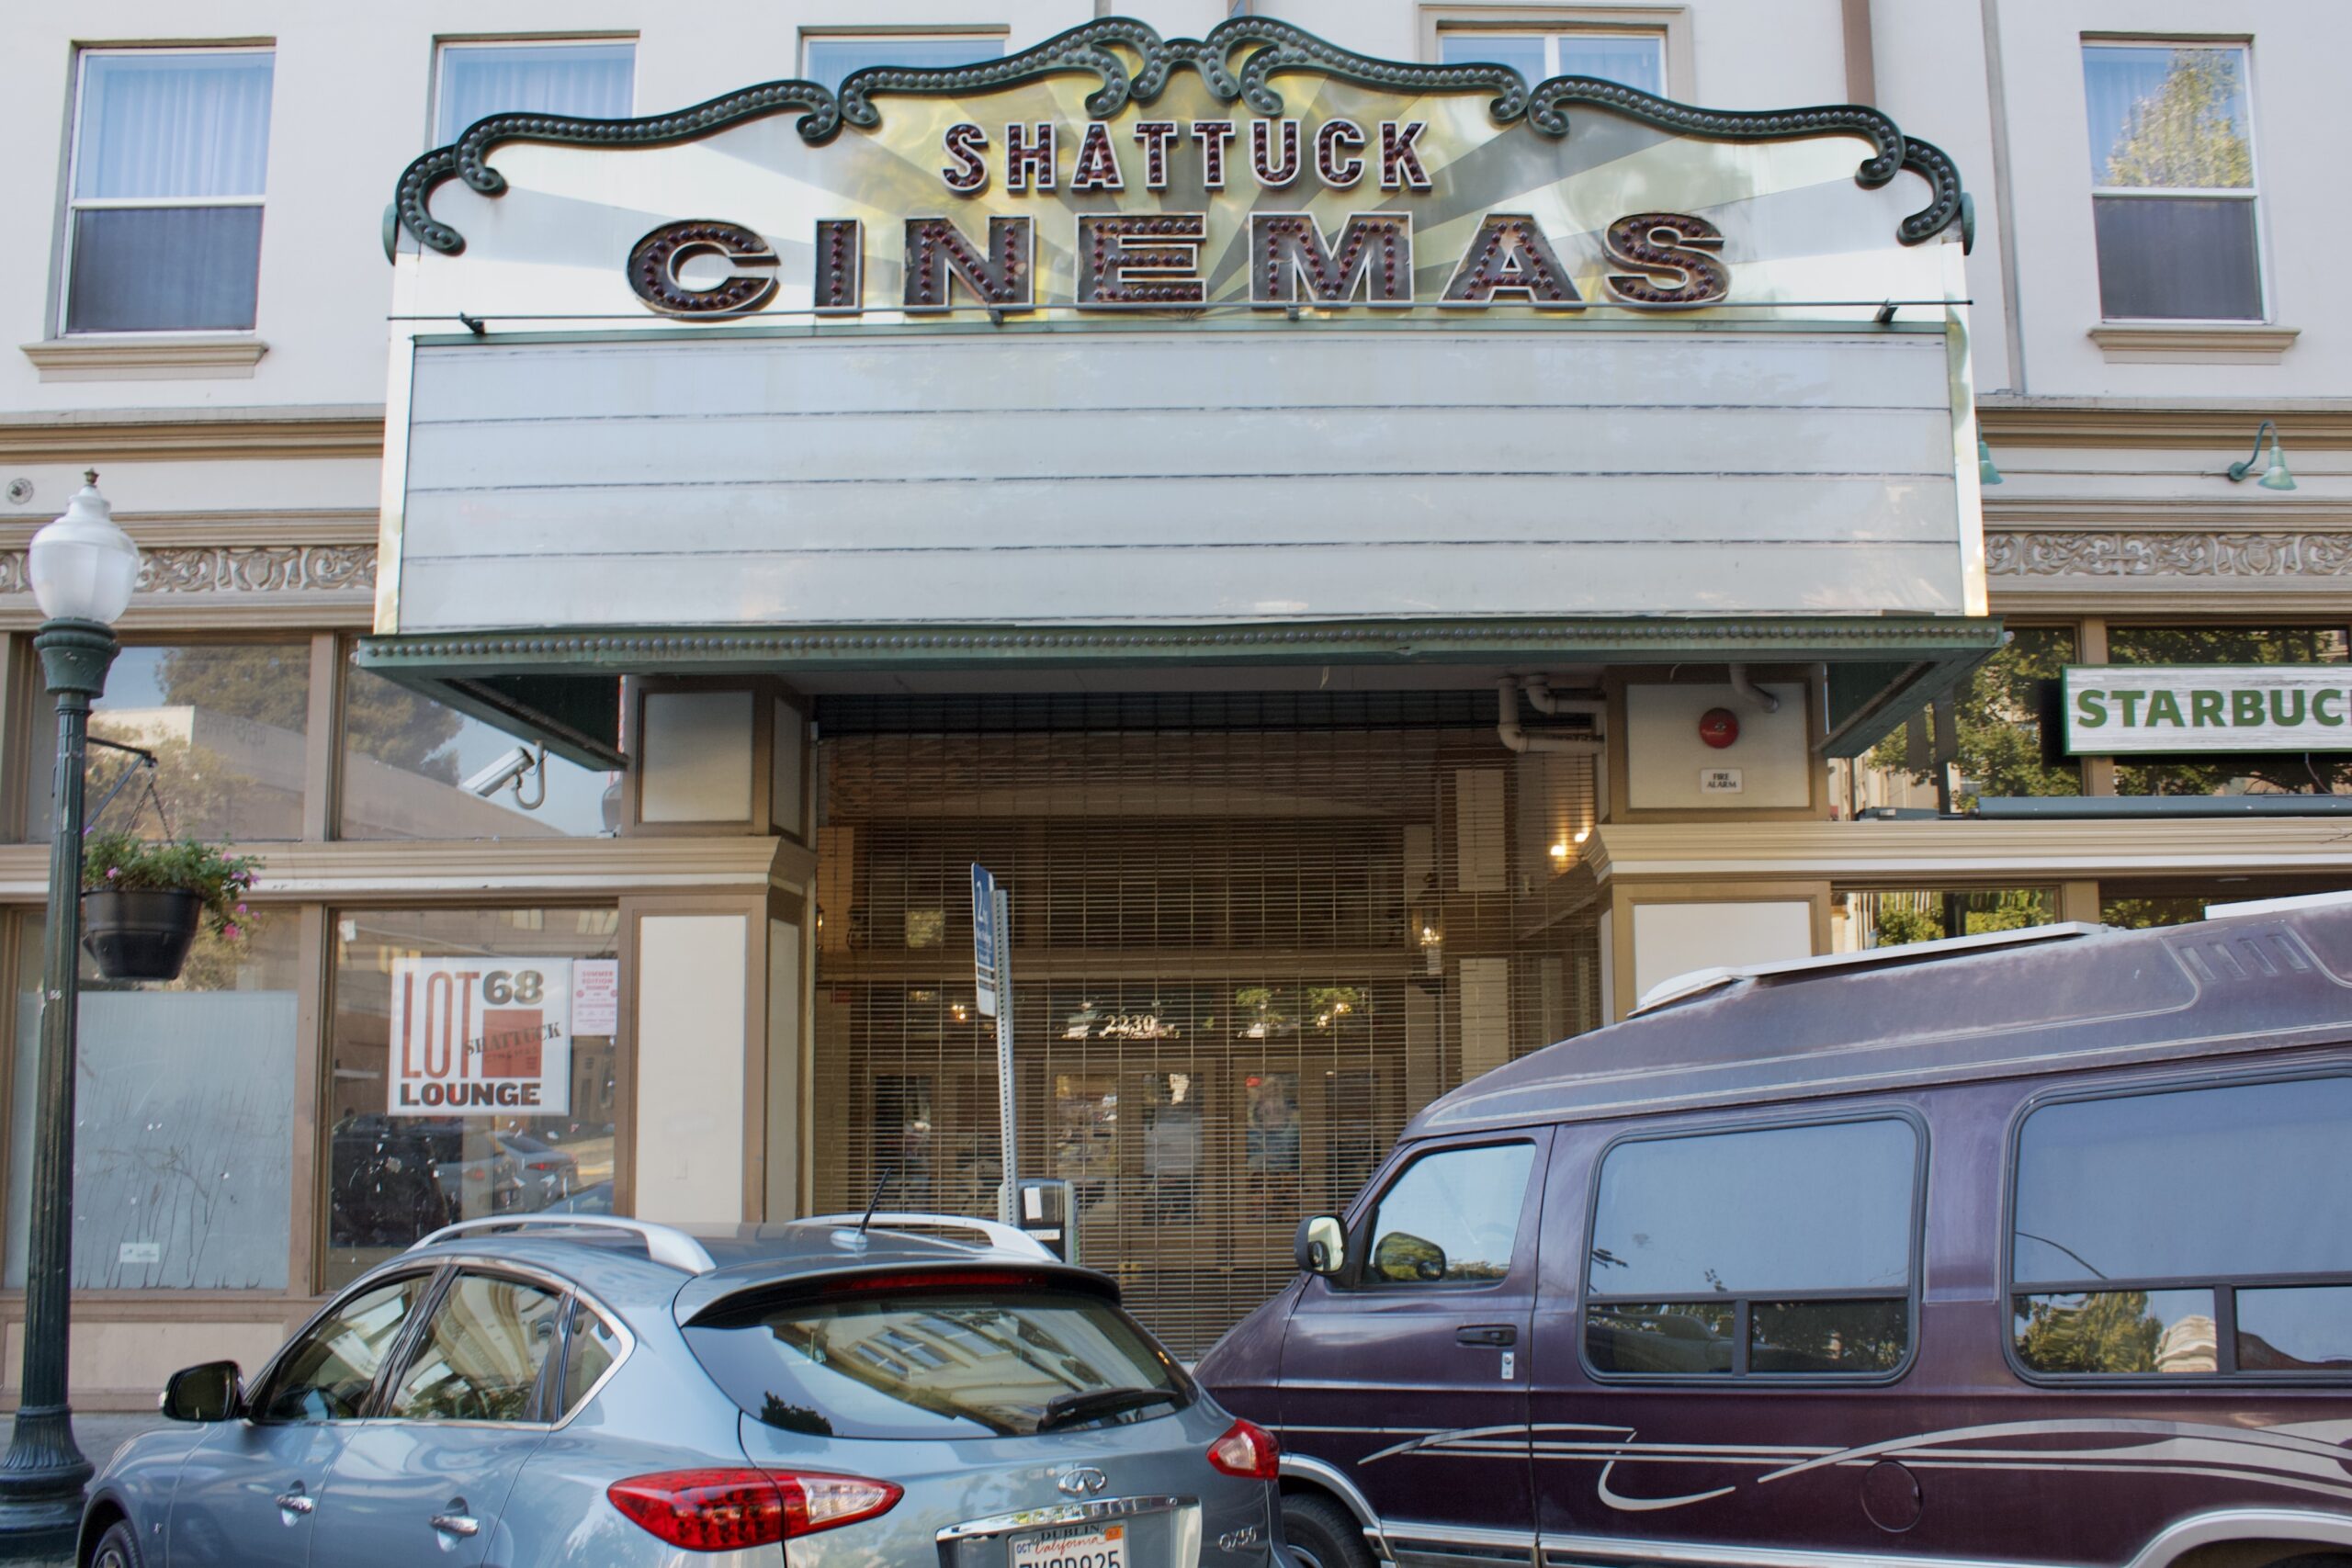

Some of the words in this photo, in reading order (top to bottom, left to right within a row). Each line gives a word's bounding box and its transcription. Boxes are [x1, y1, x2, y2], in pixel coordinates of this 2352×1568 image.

[942, 118, 1433, 196] SHATTUCK
[627, 210, 1733, 320] CINEMAS
[2076, 689, 2352, 728] STARBUC
[1713, 773, 1729, 781] FIRE
[401, 971, 481, 1079] LOT
[482, 970, 544, 1006] 68
[1104, 1014, 1156, 1032] 2230
[463, 1021, 561, 1057] SHATTUCK
[400, 1082, 541, 1107] LOUNGE
[1041, 1524, 1101, 1541] DUBLIN
[1016, 1542, 1031, 1554] OCT
[1035, 1536, 1105, 1555] California
